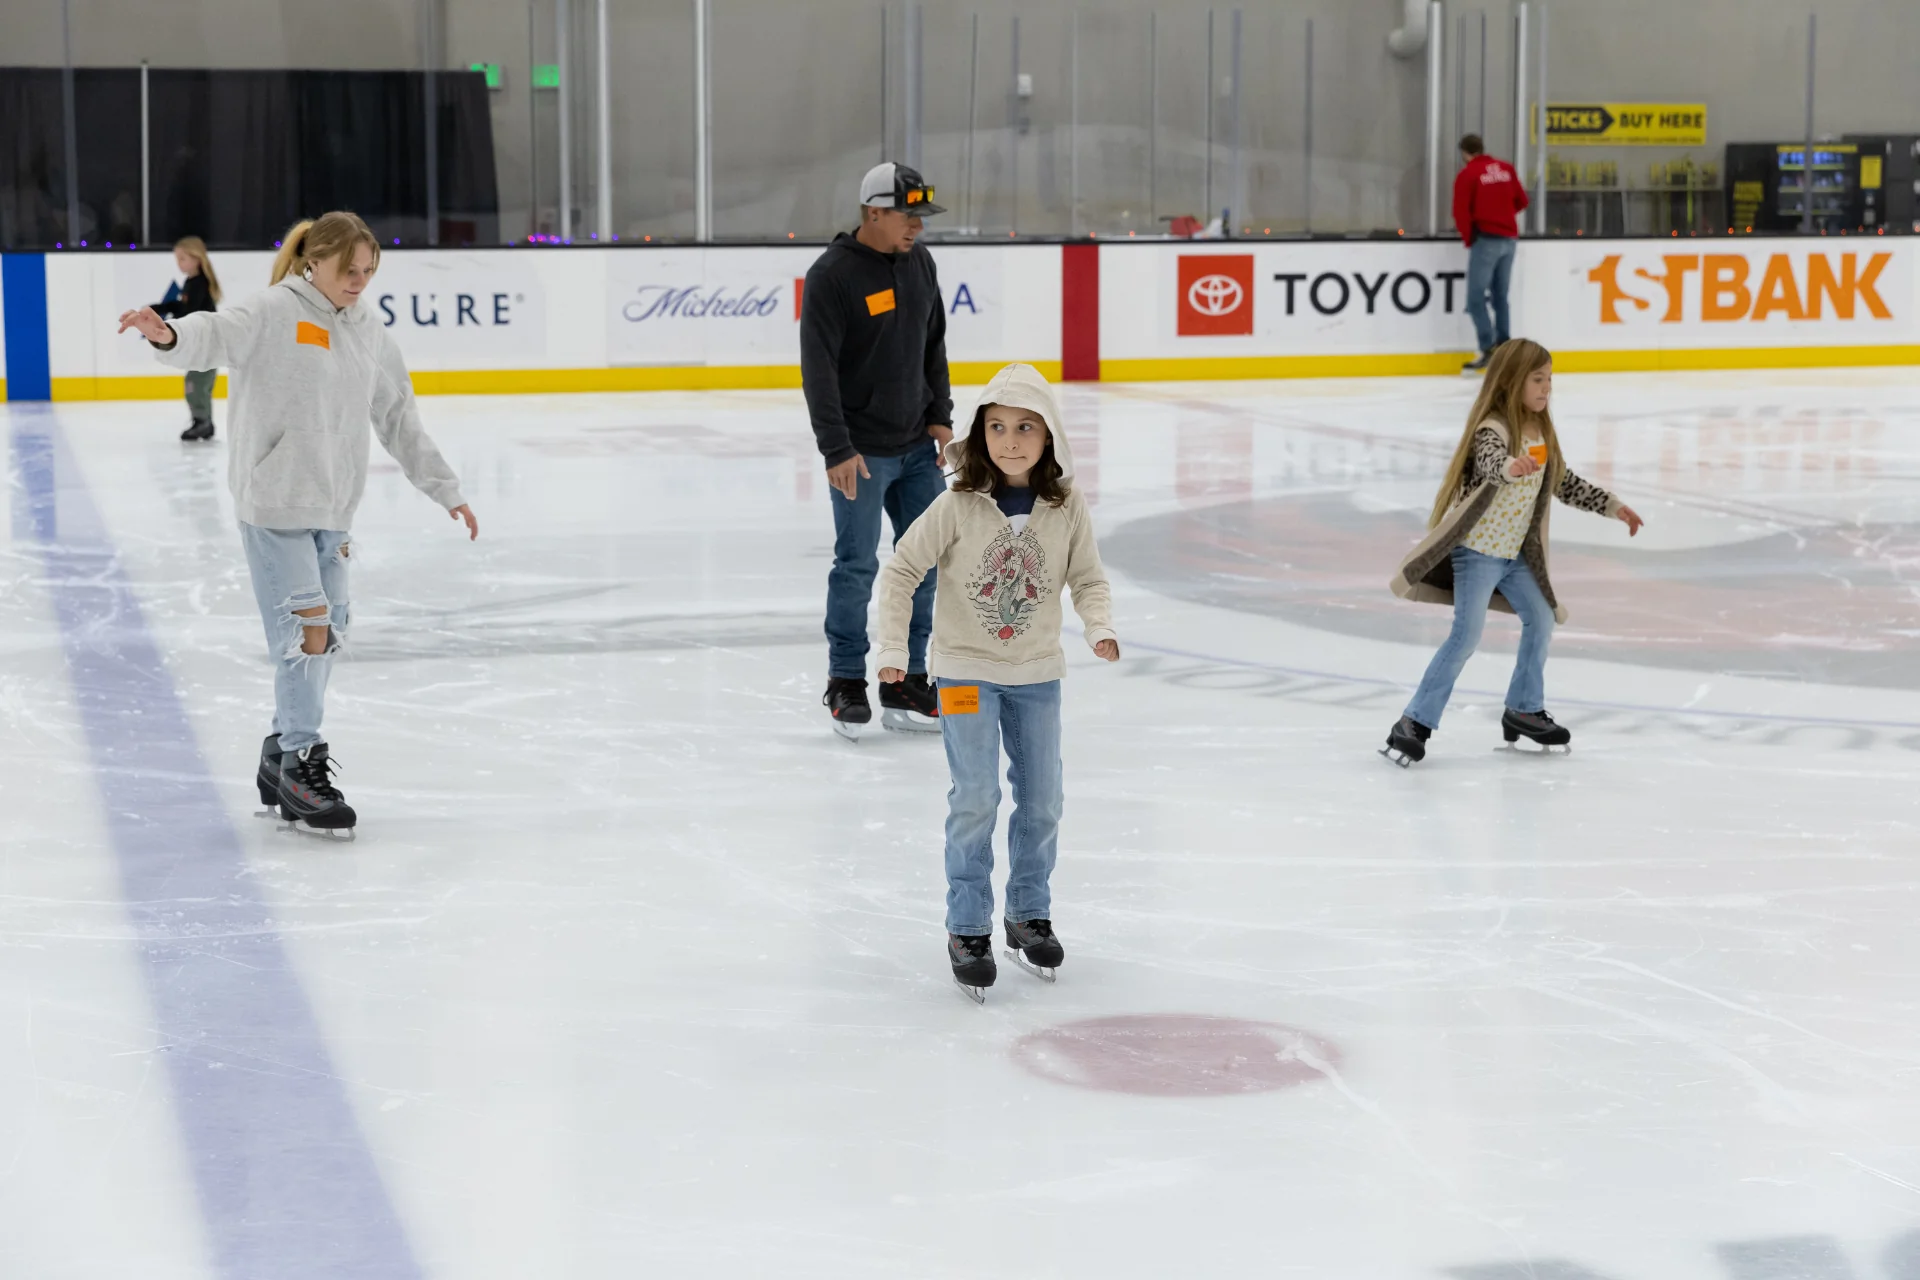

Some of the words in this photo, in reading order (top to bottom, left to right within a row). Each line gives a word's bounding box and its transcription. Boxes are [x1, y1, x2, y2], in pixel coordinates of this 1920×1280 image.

[1545, 110, 1602, 129] STICKS
[1619, 112, 1654, 129] BUY
[1659, 112, 1704, 129] HERE
[622, 284, 783, 322] Michelob
[1273, 271, 1467, 316] TOYOT
